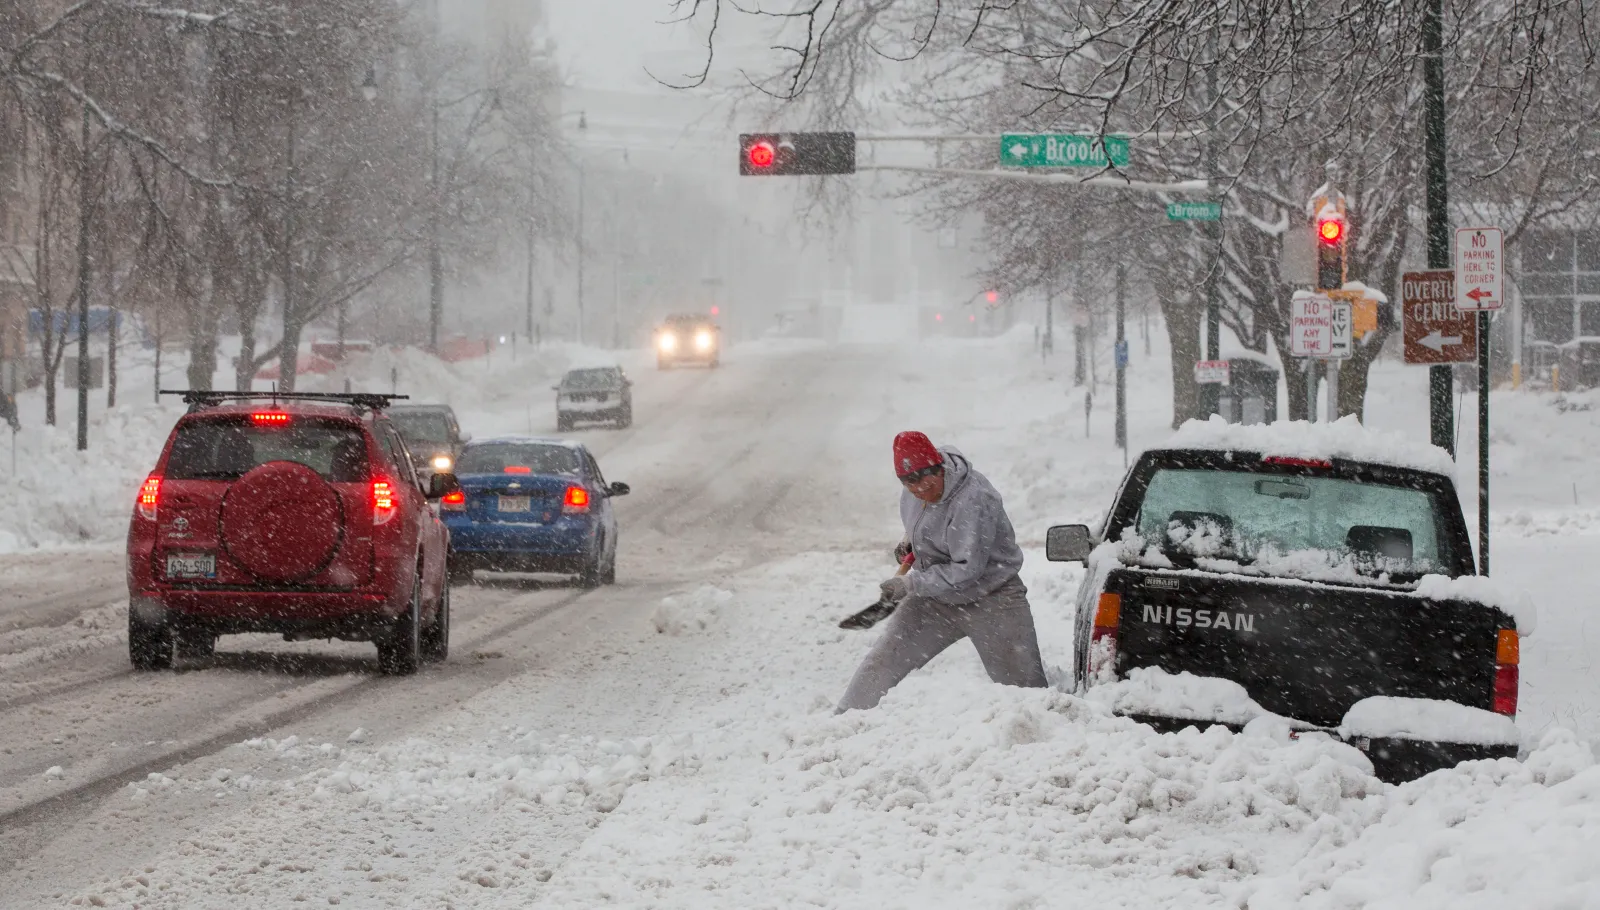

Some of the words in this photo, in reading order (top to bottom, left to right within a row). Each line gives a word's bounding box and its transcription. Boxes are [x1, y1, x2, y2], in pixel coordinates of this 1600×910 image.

[1046, 137, 1105, 161] Broom
[1175, 204, 1210, 217] Broom
[1471, 235, 1487, 248] NO
[1463, 250, 1495, 260] PARKING
[1463, 262, 1482, 272] HERE
[1486, 262, 1495, 271] TO
[1464, 274, 1494, 284] CORNER
[1404, 280, 1455, 300] OVERTU
[1304, 302, 1319, 315] NO
[1294, 317, 1329, 327] PARKING
[1303, 329, 1320, 338] ANY
[1303, 340, 1321, 350] TIME
[1142, 604, 1254, 632] NISSAN
